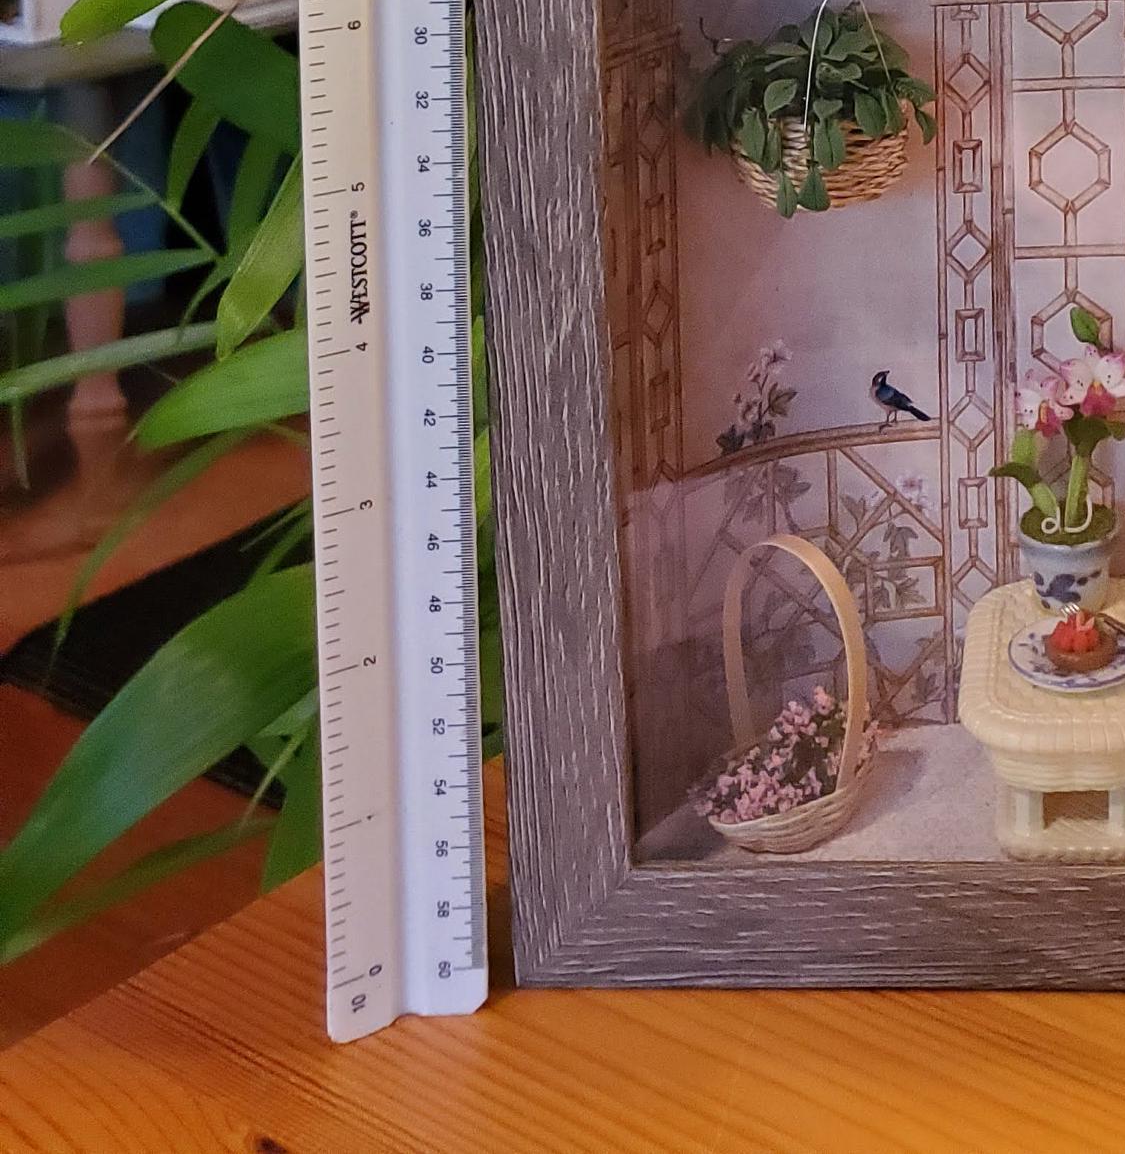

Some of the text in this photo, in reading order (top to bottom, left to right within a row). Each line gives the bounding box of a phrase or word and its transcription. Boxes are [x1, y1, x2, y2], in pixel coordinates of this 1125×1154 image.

[414, 26, 427, 45] 30
[416, 90, 429, 110] 32
[417, 154, 430, 173] 34
[351, 181, 364, 191] 5
[418, 218, 431, 237] 36
[420, 282, 433, 301] 38
[355, 342, 368, 352] 4
[422, 345, 434, 364] 40
[423, 408, 436, 427] 42
[425, 471, 437, 489] 44
[359, 499, 373, 510] 3
[427, 533, 440, 551] 46
[429, 595, 441, 613] 48
[363, 654, 376, 667] 2
[430, 656, 443, 674] 50
[432, 718, 445, 736] 52
[434, 779, 447, 796] 54
[435, 839, 448, 858] 56
[437, 900, 450, 918] 58
[438, 960, 451, 979] 60
[351, 994, 367, 1013] 10
